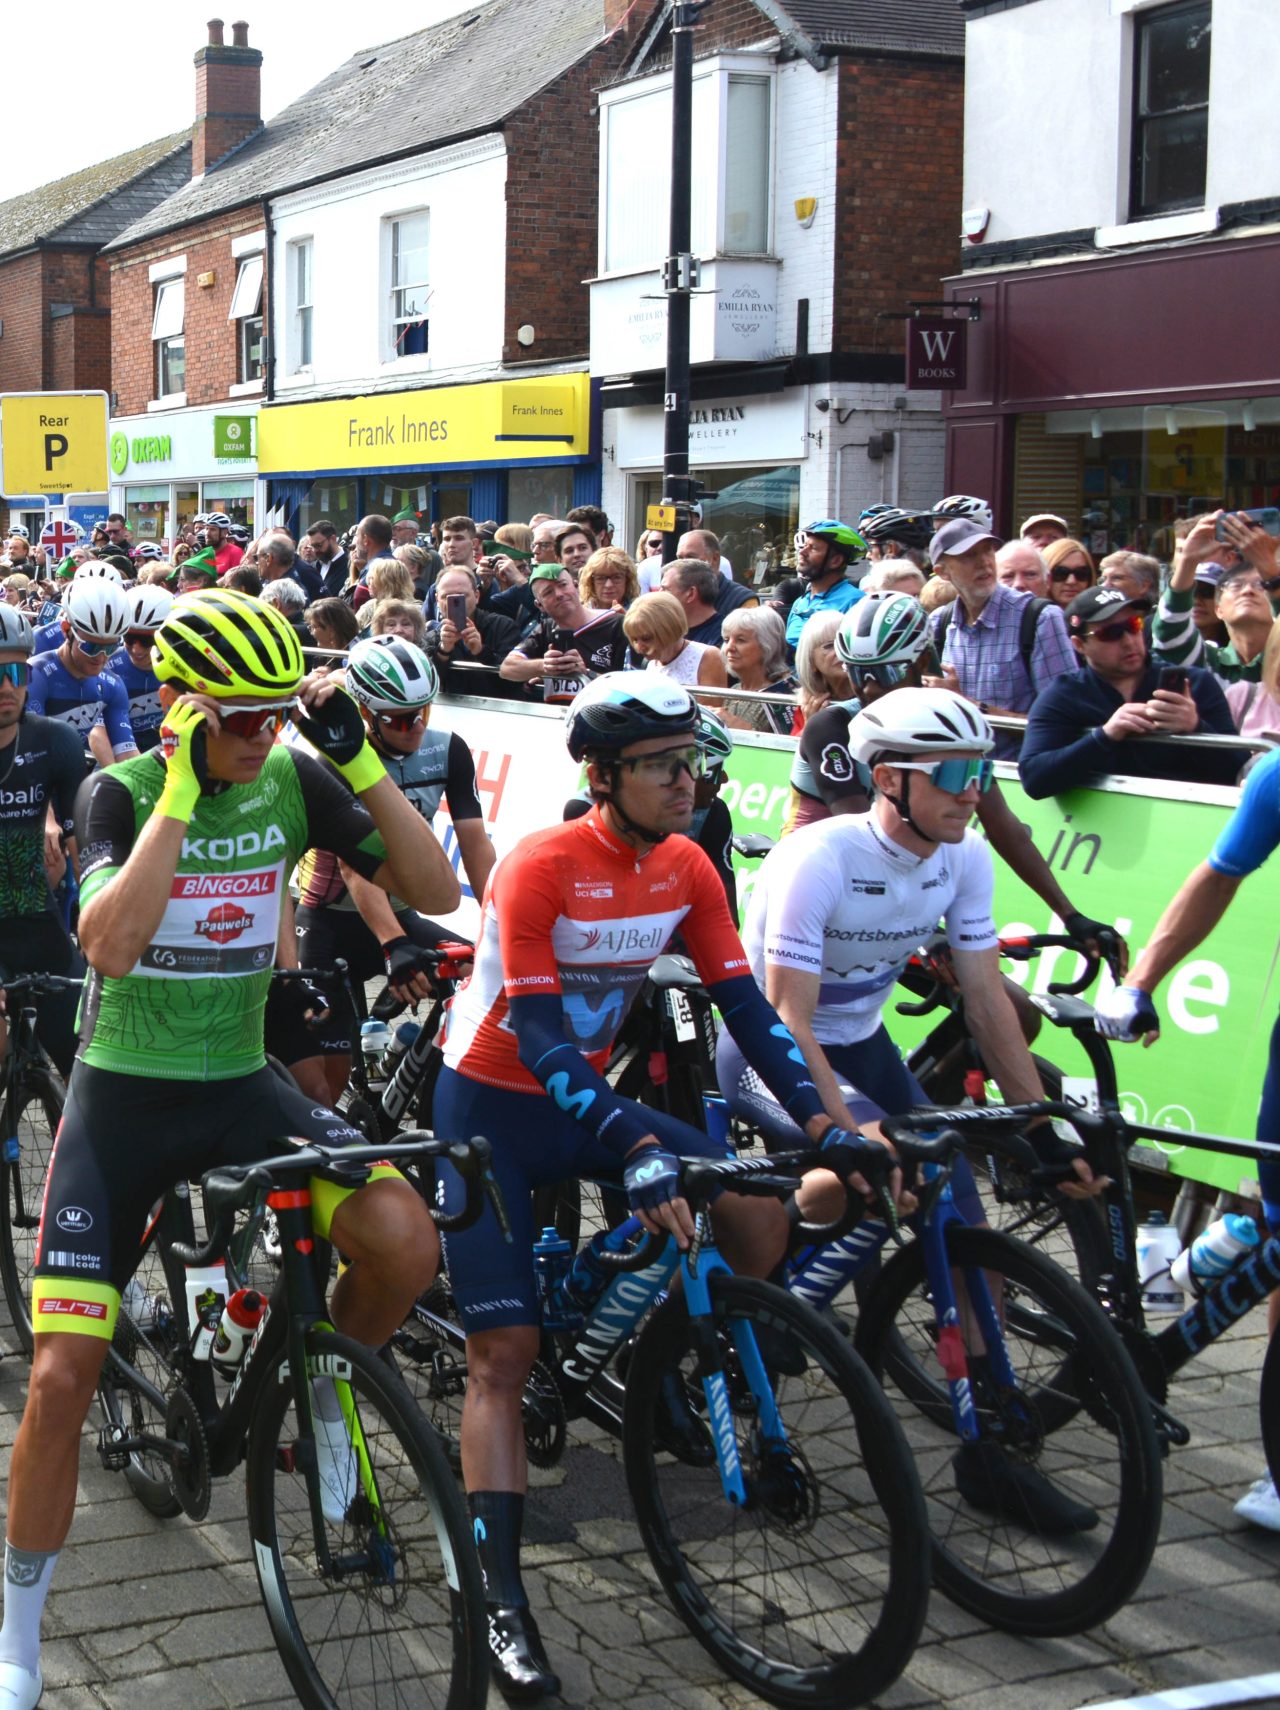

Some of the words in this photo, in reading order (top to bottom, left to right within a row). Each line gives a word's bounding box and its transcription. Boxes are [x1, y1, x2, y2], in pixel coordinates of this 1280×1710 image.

[718, 302, 749, 312] EMILIA
[751, 302, 774, 312] RYAN
[919, 331, 956, 361] W
[918, 368, 956, 378] BOOKS
[512, 404, 538, 416] Frank
[540, 405, 564, 416] Innes
[665, 394, 674, 410] 4
[39, 415, 70, 427] Rear
[711, 405, 746, 423] RYAN
[348, 415, 396, 448] Frank
[401, 413, 449, 444] Innes
[689, 427, 738, 440] WELLERY
[223, 443, 245, 451] OXFAM
[1233, 433, 1280, 448] FICTI
[44, 433, 69, 471] P
[132, 434, 172, 464] OXFAM
[883, 607, 900, 625] Qlik
[180, 823, 287, 862] KODA
[1061, 815, 1102, 875] in
[575, 890, 589, 898] UCI
[200, 916, 251, 933] Pauwels
[775, 948, 821, 966] MADISON
[504, 975, 555, 987] MADISON
[677, 997, 694, 1025] 58
[702, 1009, 716, 1062] CANYON
[60, 1220, 87, 1229] vermarc
[75, 1253, 101, 1262] color
[75, 1261, 101, 1270] code
[41, 1300, 104, 1316] ELITE
[465, 1298, 524, 1315] CANYON
[561, 1262, 668, 1383] CANYON
